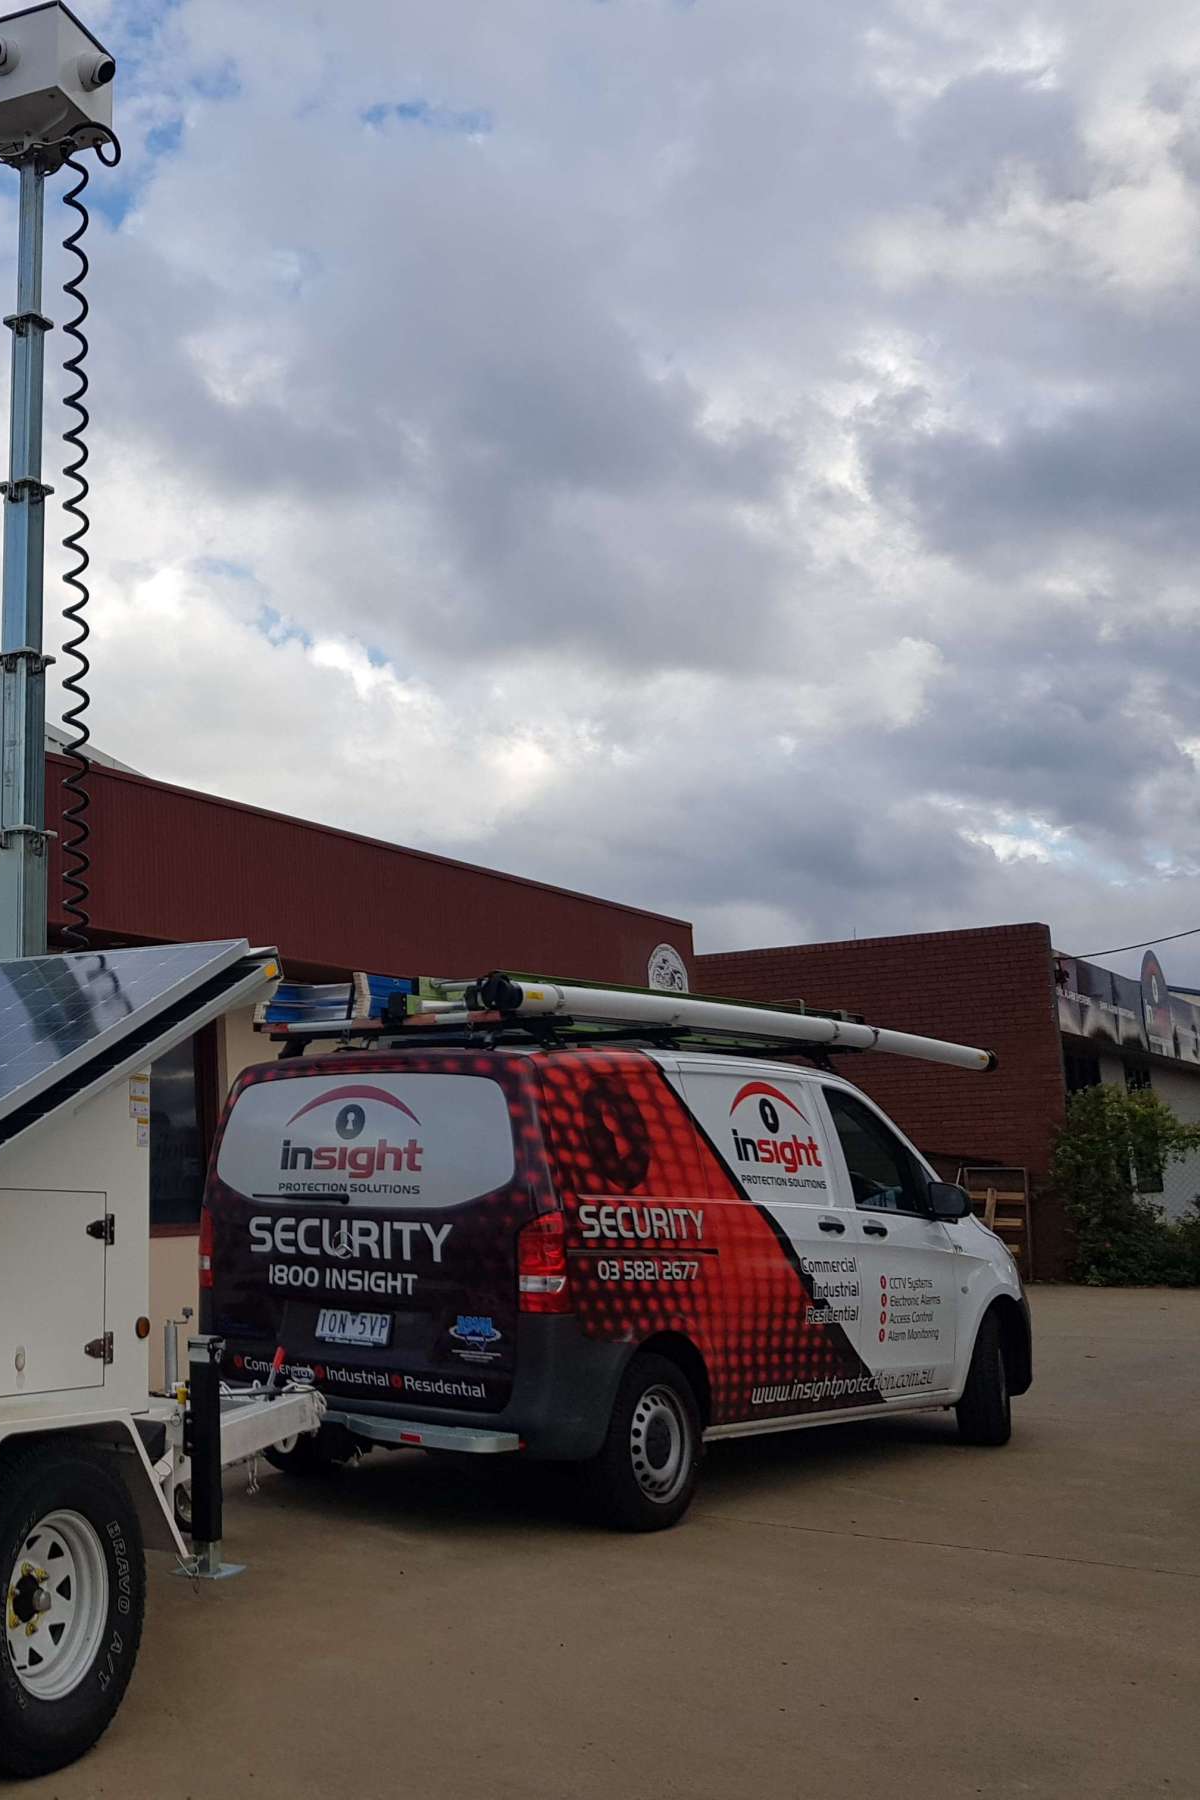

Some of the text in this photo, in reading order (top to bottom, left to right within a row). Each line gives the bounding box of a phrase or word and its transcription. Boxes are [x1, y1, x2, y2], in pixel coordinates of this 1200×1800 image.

[280, 1139, 424, 1179] insight
[731, 1129, 822, 1173] insight
[278, 1182, 421, 1195] PROTECTION SOLUTIONS
[741, 1174, 827, 1190] PROTECTION SOLUTIONS
[579, 1205, 704, 1240] SECURITY
[248, 1216, 454, 1263] SECURITY
[598, 1261, 699, 1281] 03 5821 2677
[801, 1257, 857, 1273] Commercial
[268, 1263, 419, 1296] 1800 INSIGHT
[814, 1281, 860, 1298] Industrial
[889, 1277, 907, 1290] CCTV
[806, 1305, 859, 1323] Residential
[889, 1312, 911, 1324] Access
[326, 1368, 390, 1387] Industrial
[404, 1376, 487, 1399] Residential
[105, 1520, 130, 1615] BRAVO
